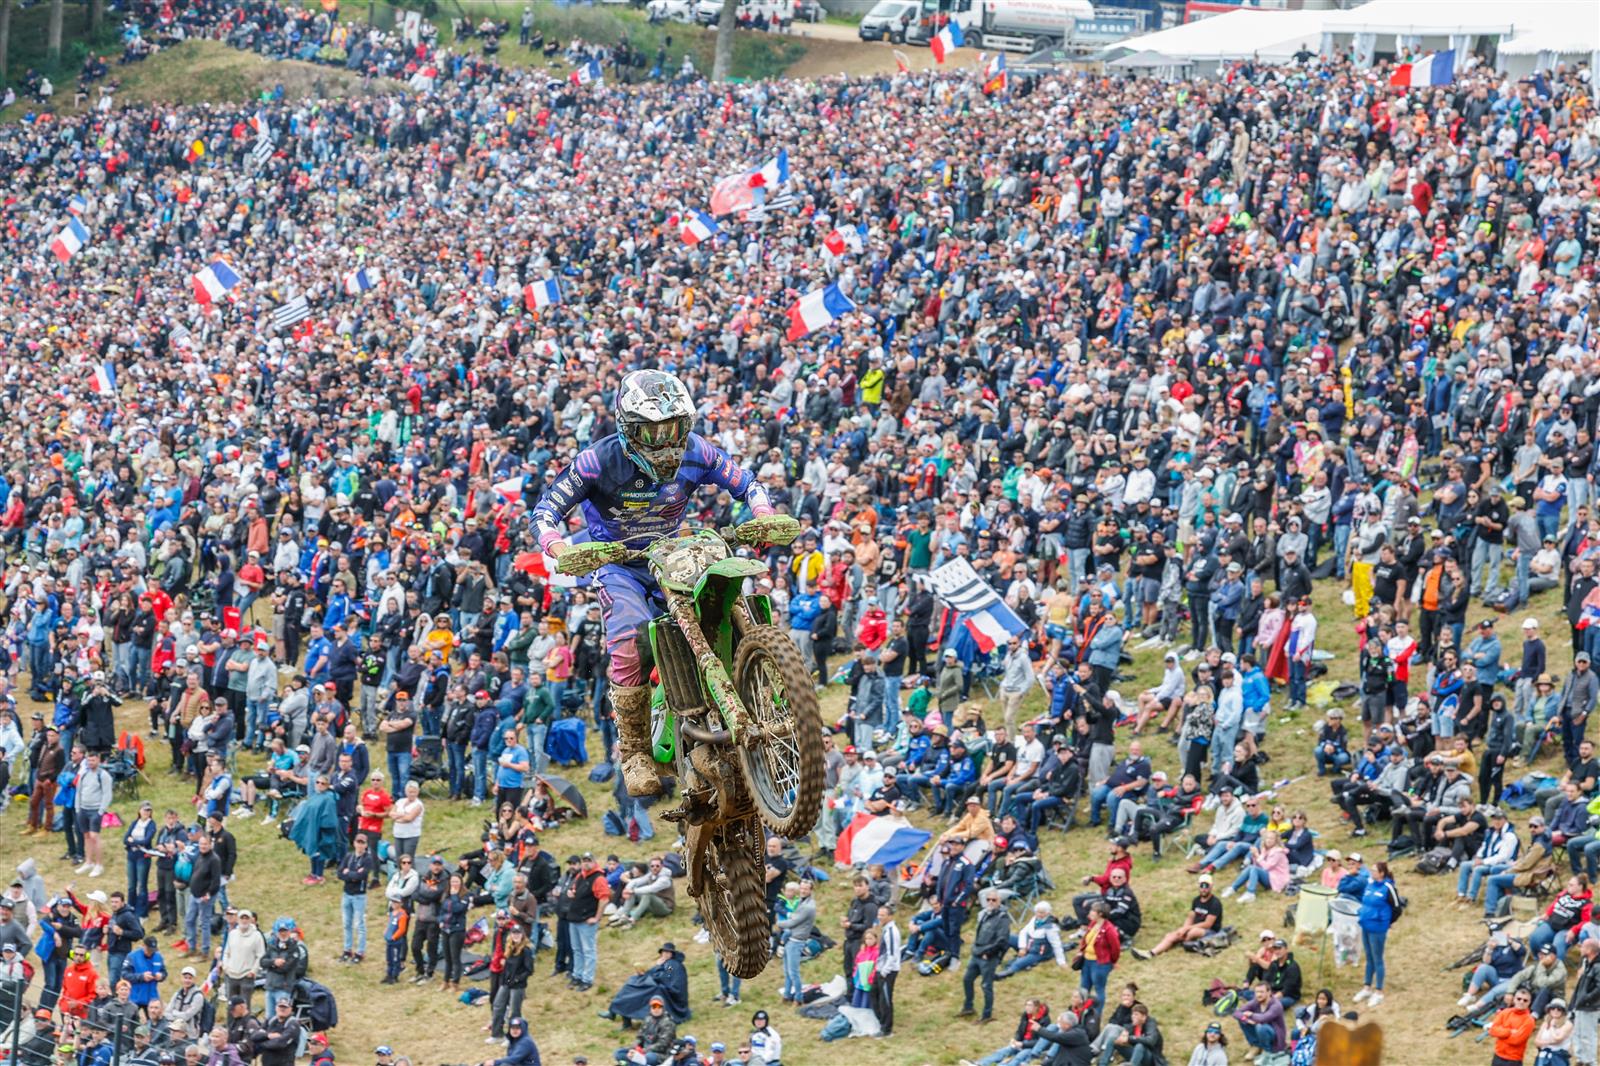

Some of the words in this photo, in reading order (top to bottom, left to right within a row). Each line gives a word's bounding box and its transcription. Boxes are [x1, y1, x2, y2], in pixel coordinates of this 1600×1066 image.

[1078, 23, 1097, 32] VIP
[1100, 23, 1130, 33] GOLD
[629, 491, 658, 499] MOTOREX
